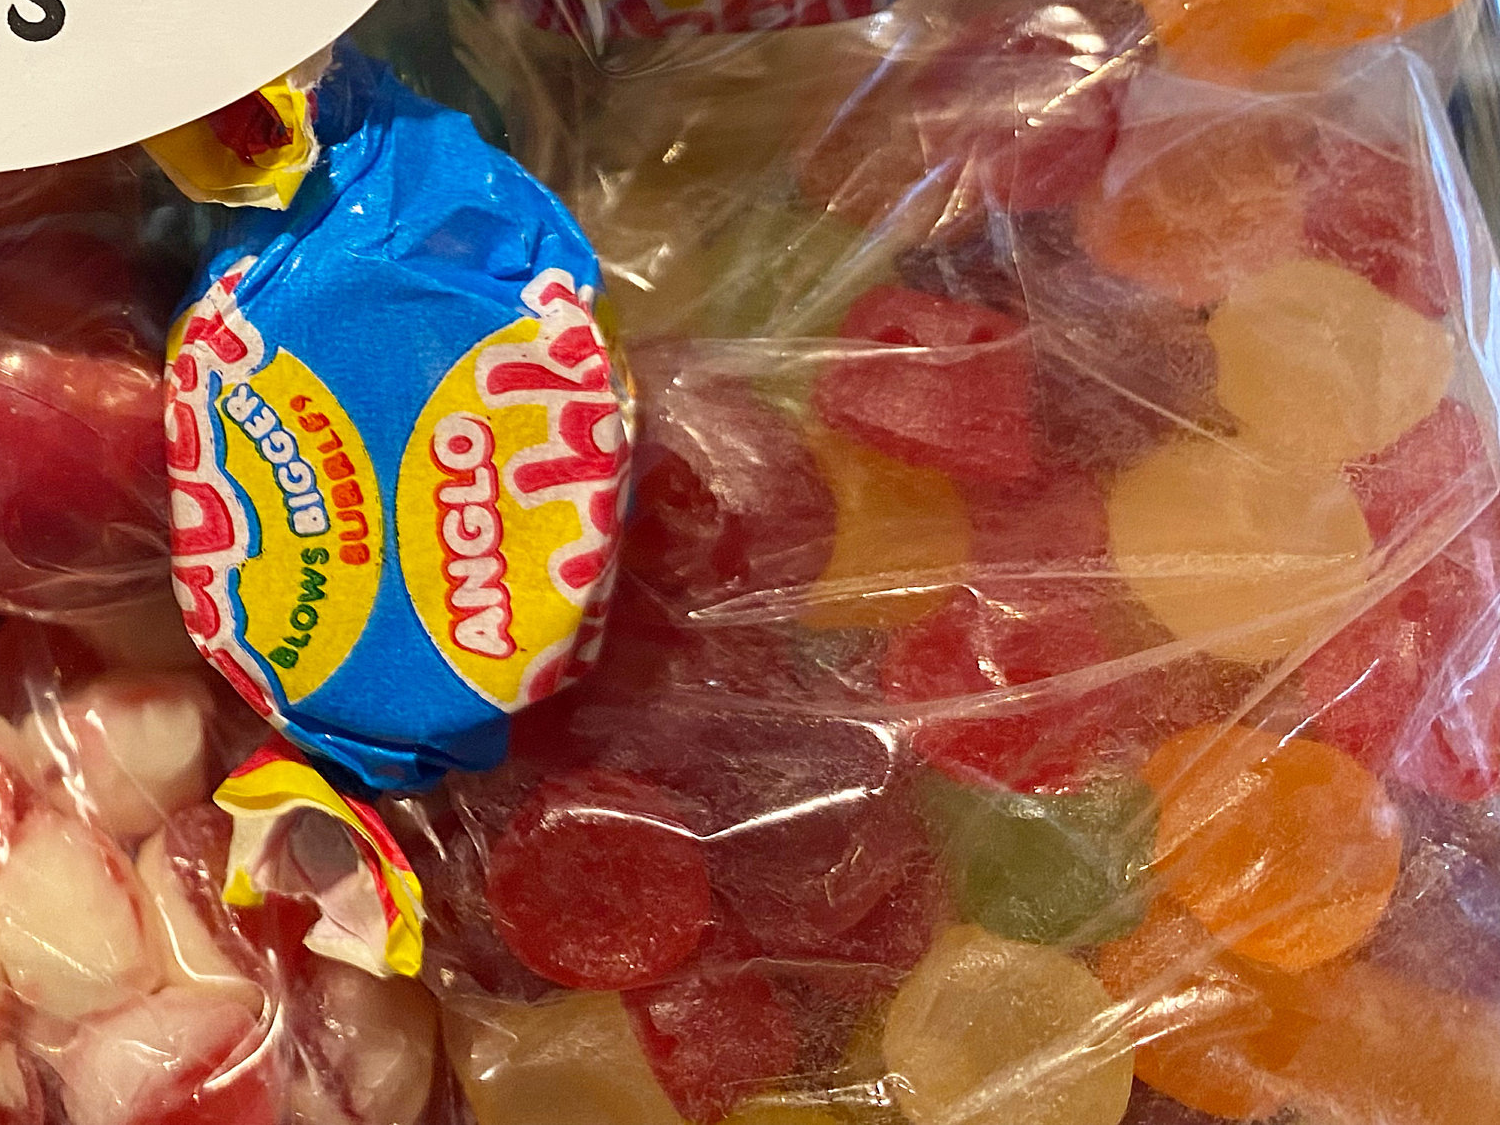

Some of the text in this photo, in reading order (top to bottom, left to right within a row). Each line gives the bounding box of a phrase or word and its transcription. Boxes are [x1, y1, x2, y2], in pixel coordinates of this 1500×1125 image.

[220, 381, 331, 670] BLOWS BIGGER
[429, 410, 517, 660] ANGLO
